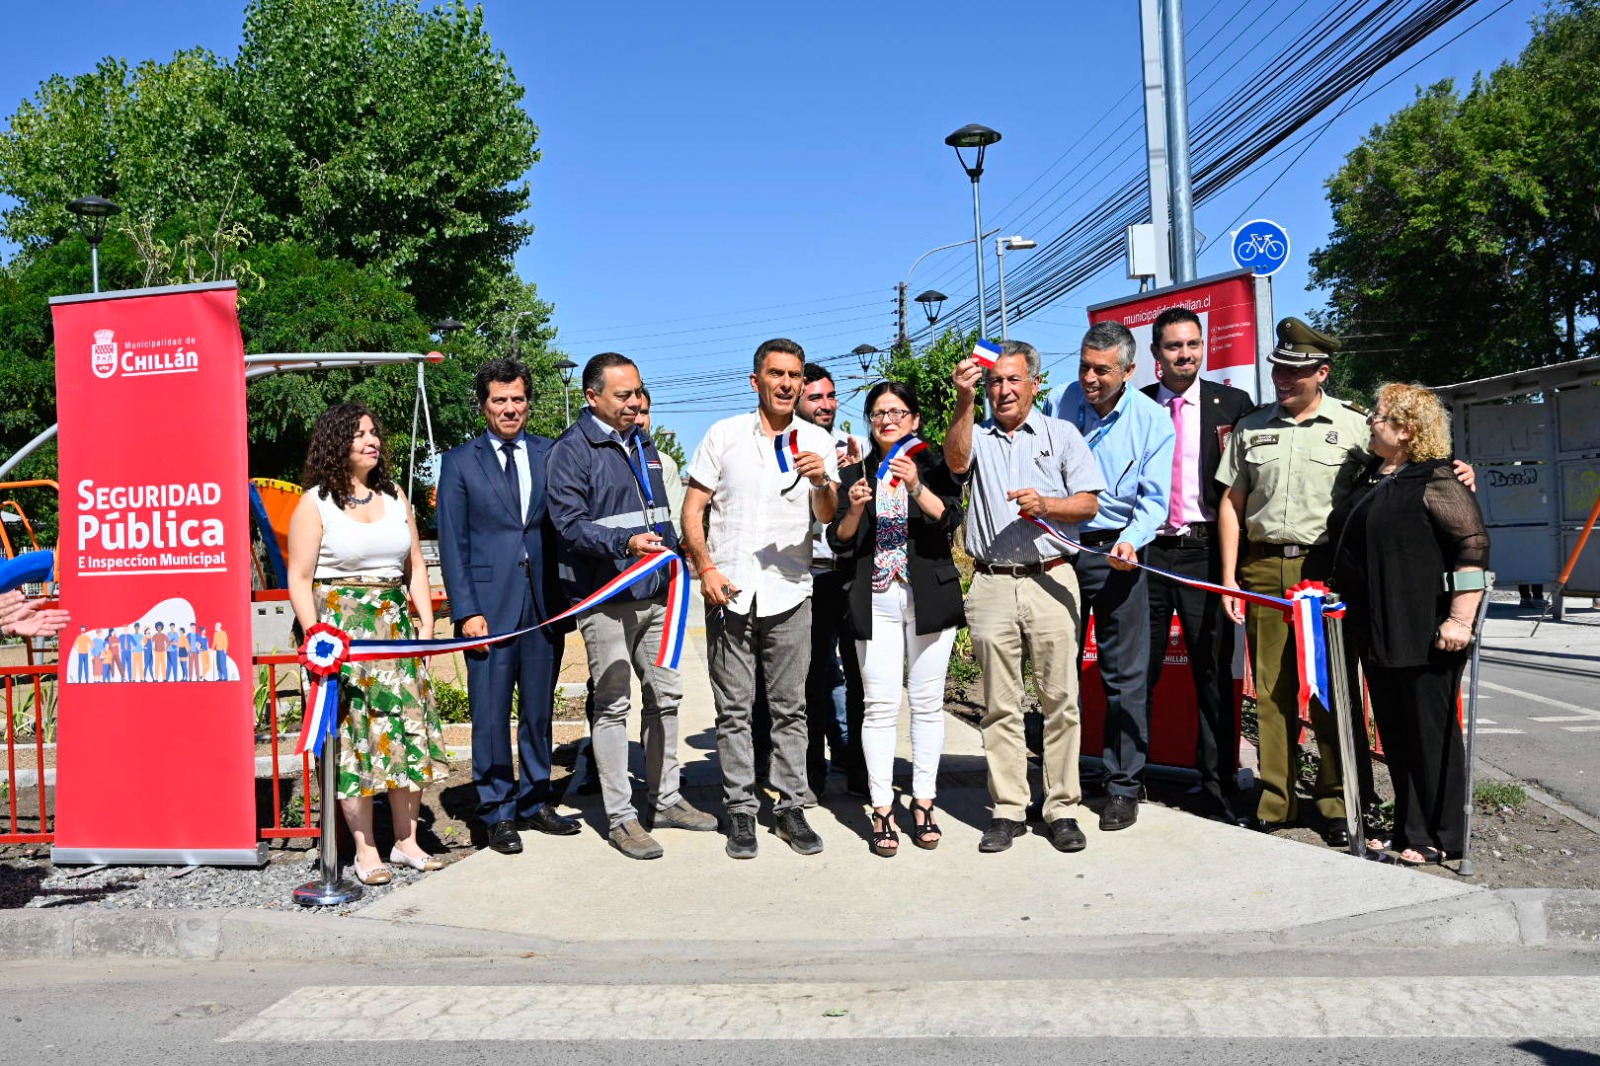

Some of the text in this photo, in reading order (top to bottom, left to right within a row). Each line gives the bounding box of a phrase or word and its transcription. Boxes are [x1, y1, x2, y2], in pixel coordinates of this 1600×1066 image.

[124, 336, 196, 350] Municipalidad de
[121, 347, 198, 372] CHILLán
[77, 479, 221, 511] SEGURIDAD
[78, 510, 224, 551] Pública
[78, 556, 85, 569] E
[159, 551, 226, 568] Municipal
[1082, 650, 1097, 659] CHILL
[1162, 653, 1188, 663] HILLán
